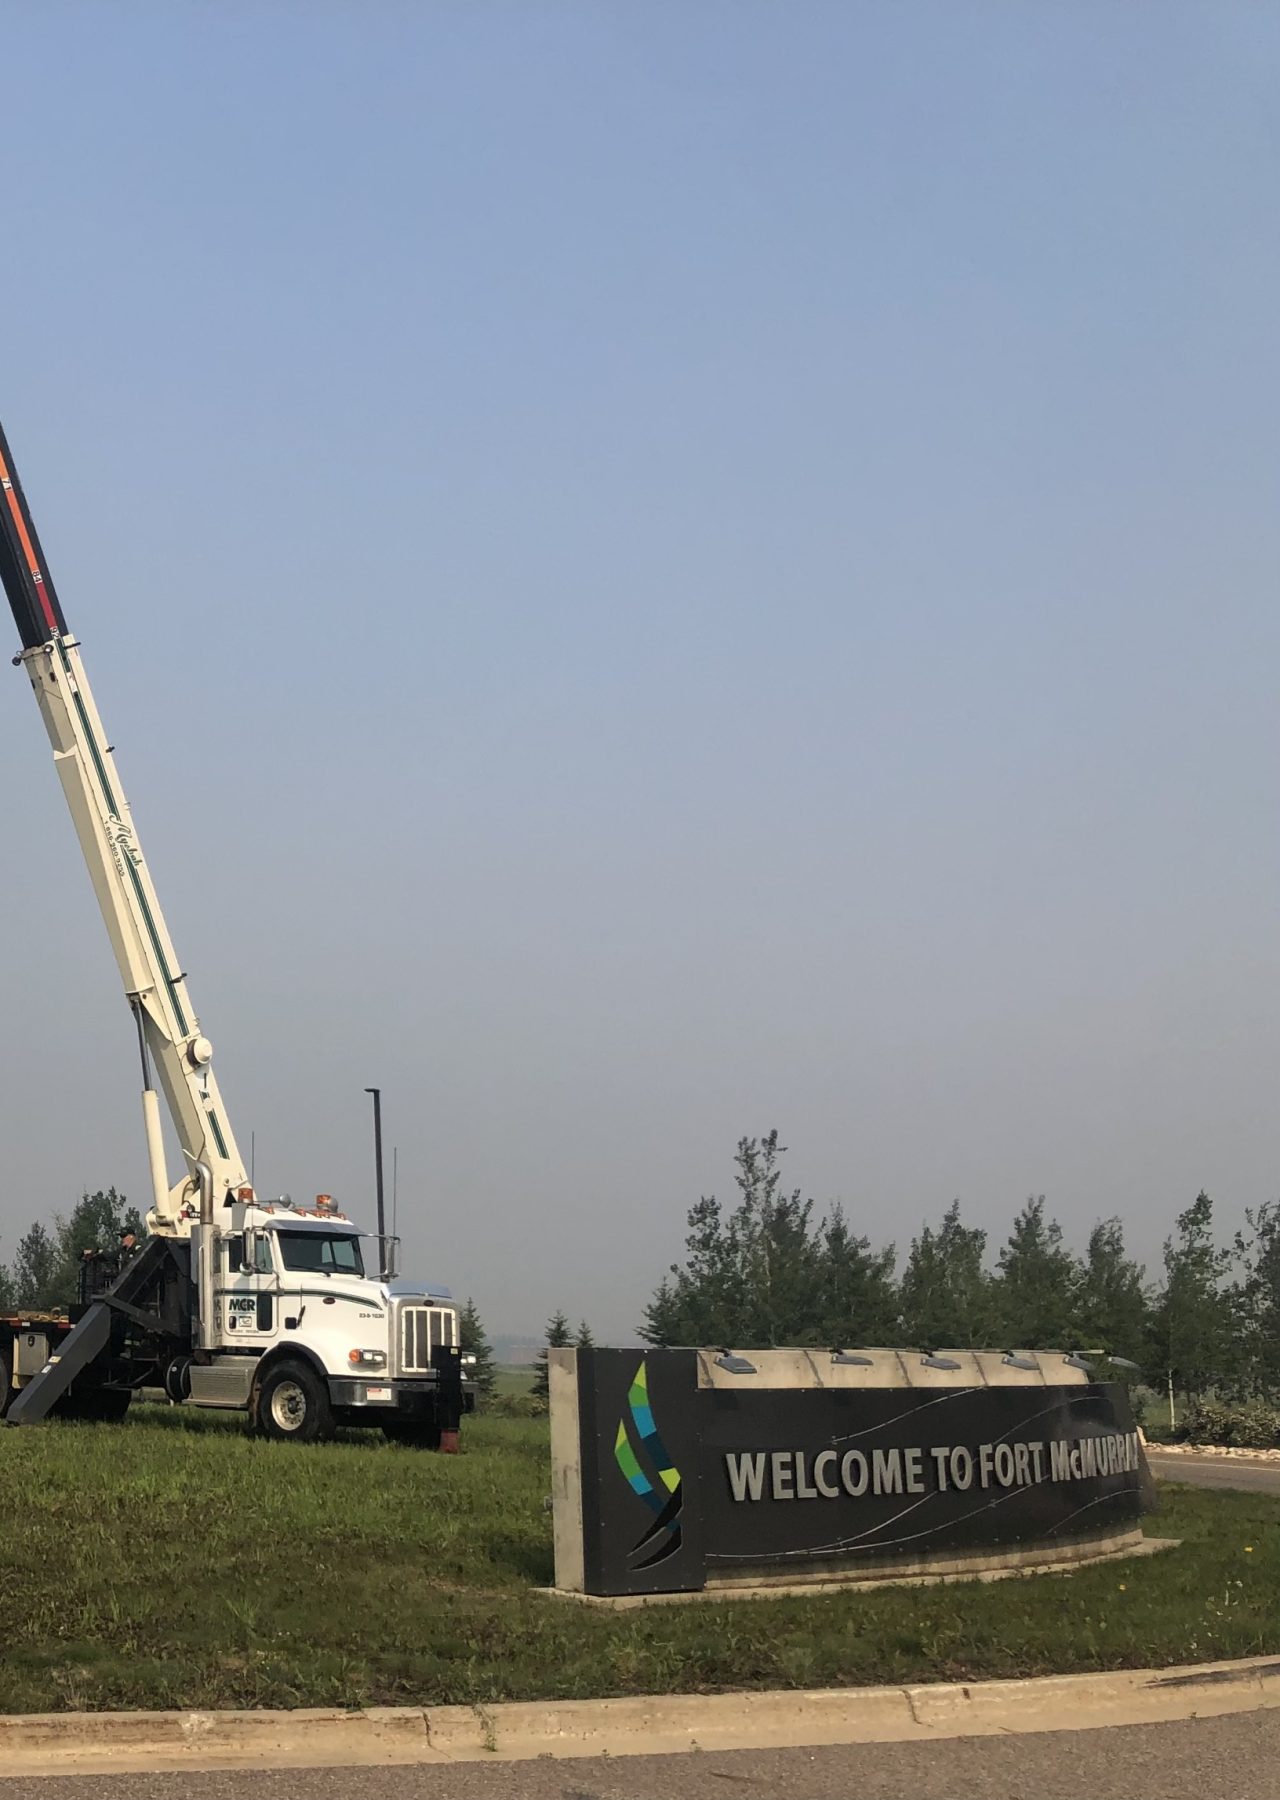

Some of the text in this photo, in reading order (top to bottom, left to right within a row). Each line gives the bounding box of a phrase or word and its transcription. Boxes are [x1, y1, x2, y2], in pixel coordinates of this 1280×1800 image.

[32, 570, 42, 583] 84
[50, 627, 60, 639] 92
[725, 1447, 925, 1501] WELCOME
[930, 1445, 973, 1492] TO
[979, 1441, 1043, 1489] FORT
